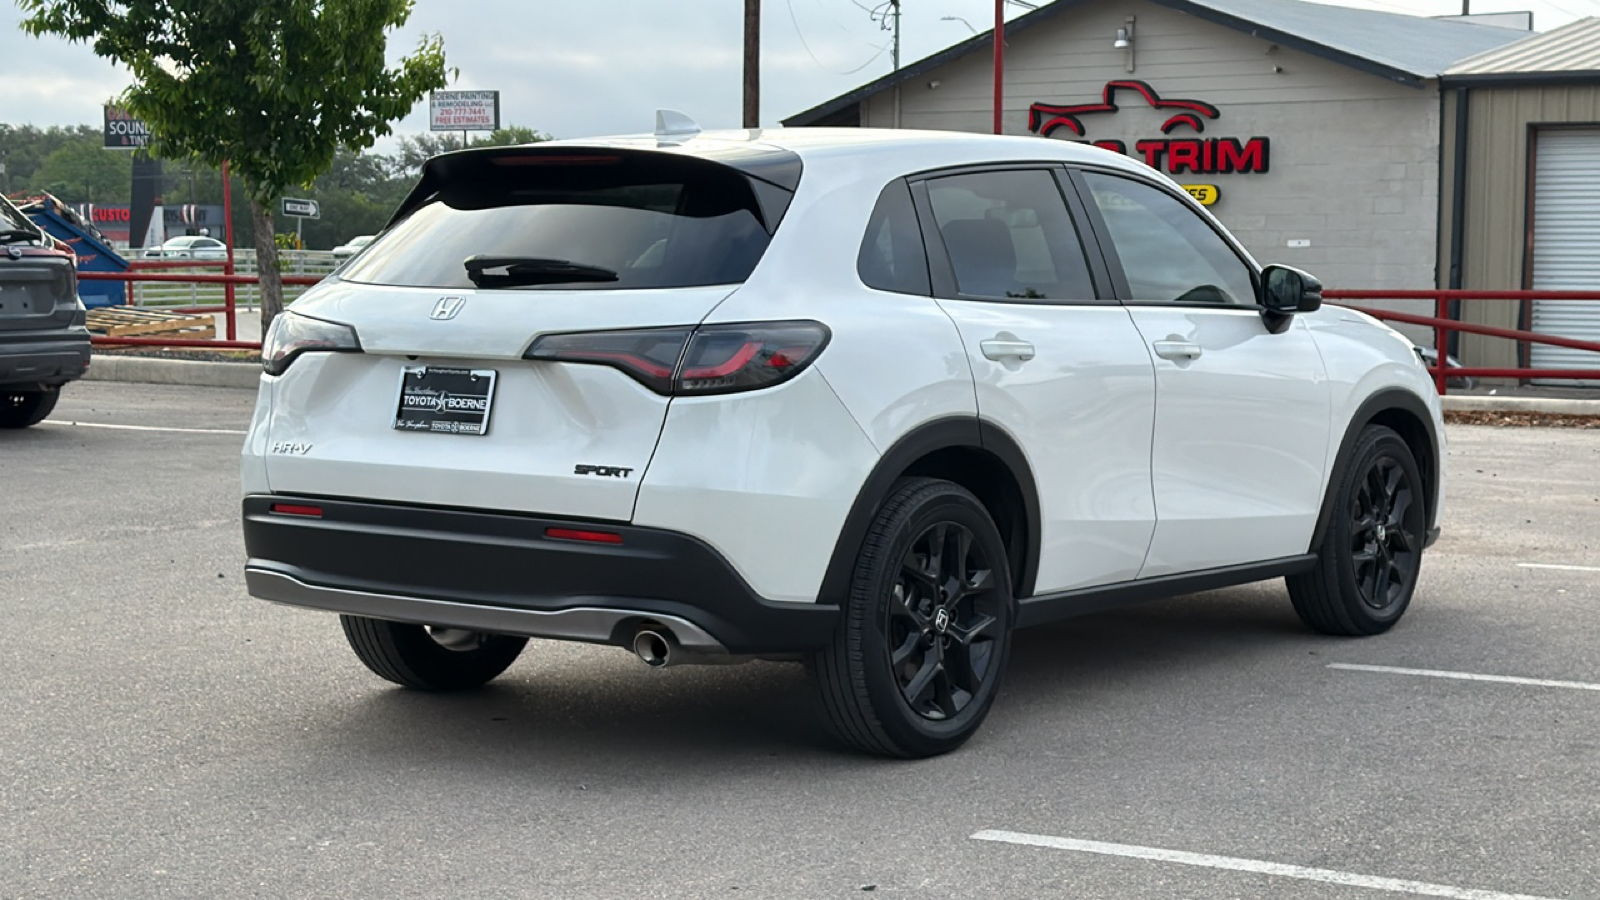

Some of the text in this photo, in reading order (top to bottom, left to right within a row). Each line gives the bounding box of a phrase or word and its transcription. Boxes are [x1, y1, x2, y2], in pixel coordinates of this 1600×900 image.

[460, 91, 494, 100] PAINTING
[435, 115, 490, 124] FREE ESTIMATES
[1136, 136, 1270, 174] TRIM
[93, 208, 131, 221] CUSTO
[403, 395, 487, 410] TOYOTA BOERNE
[271, 441, 313, 455] HR-V
[574, 464, 634, 478] SPORT
